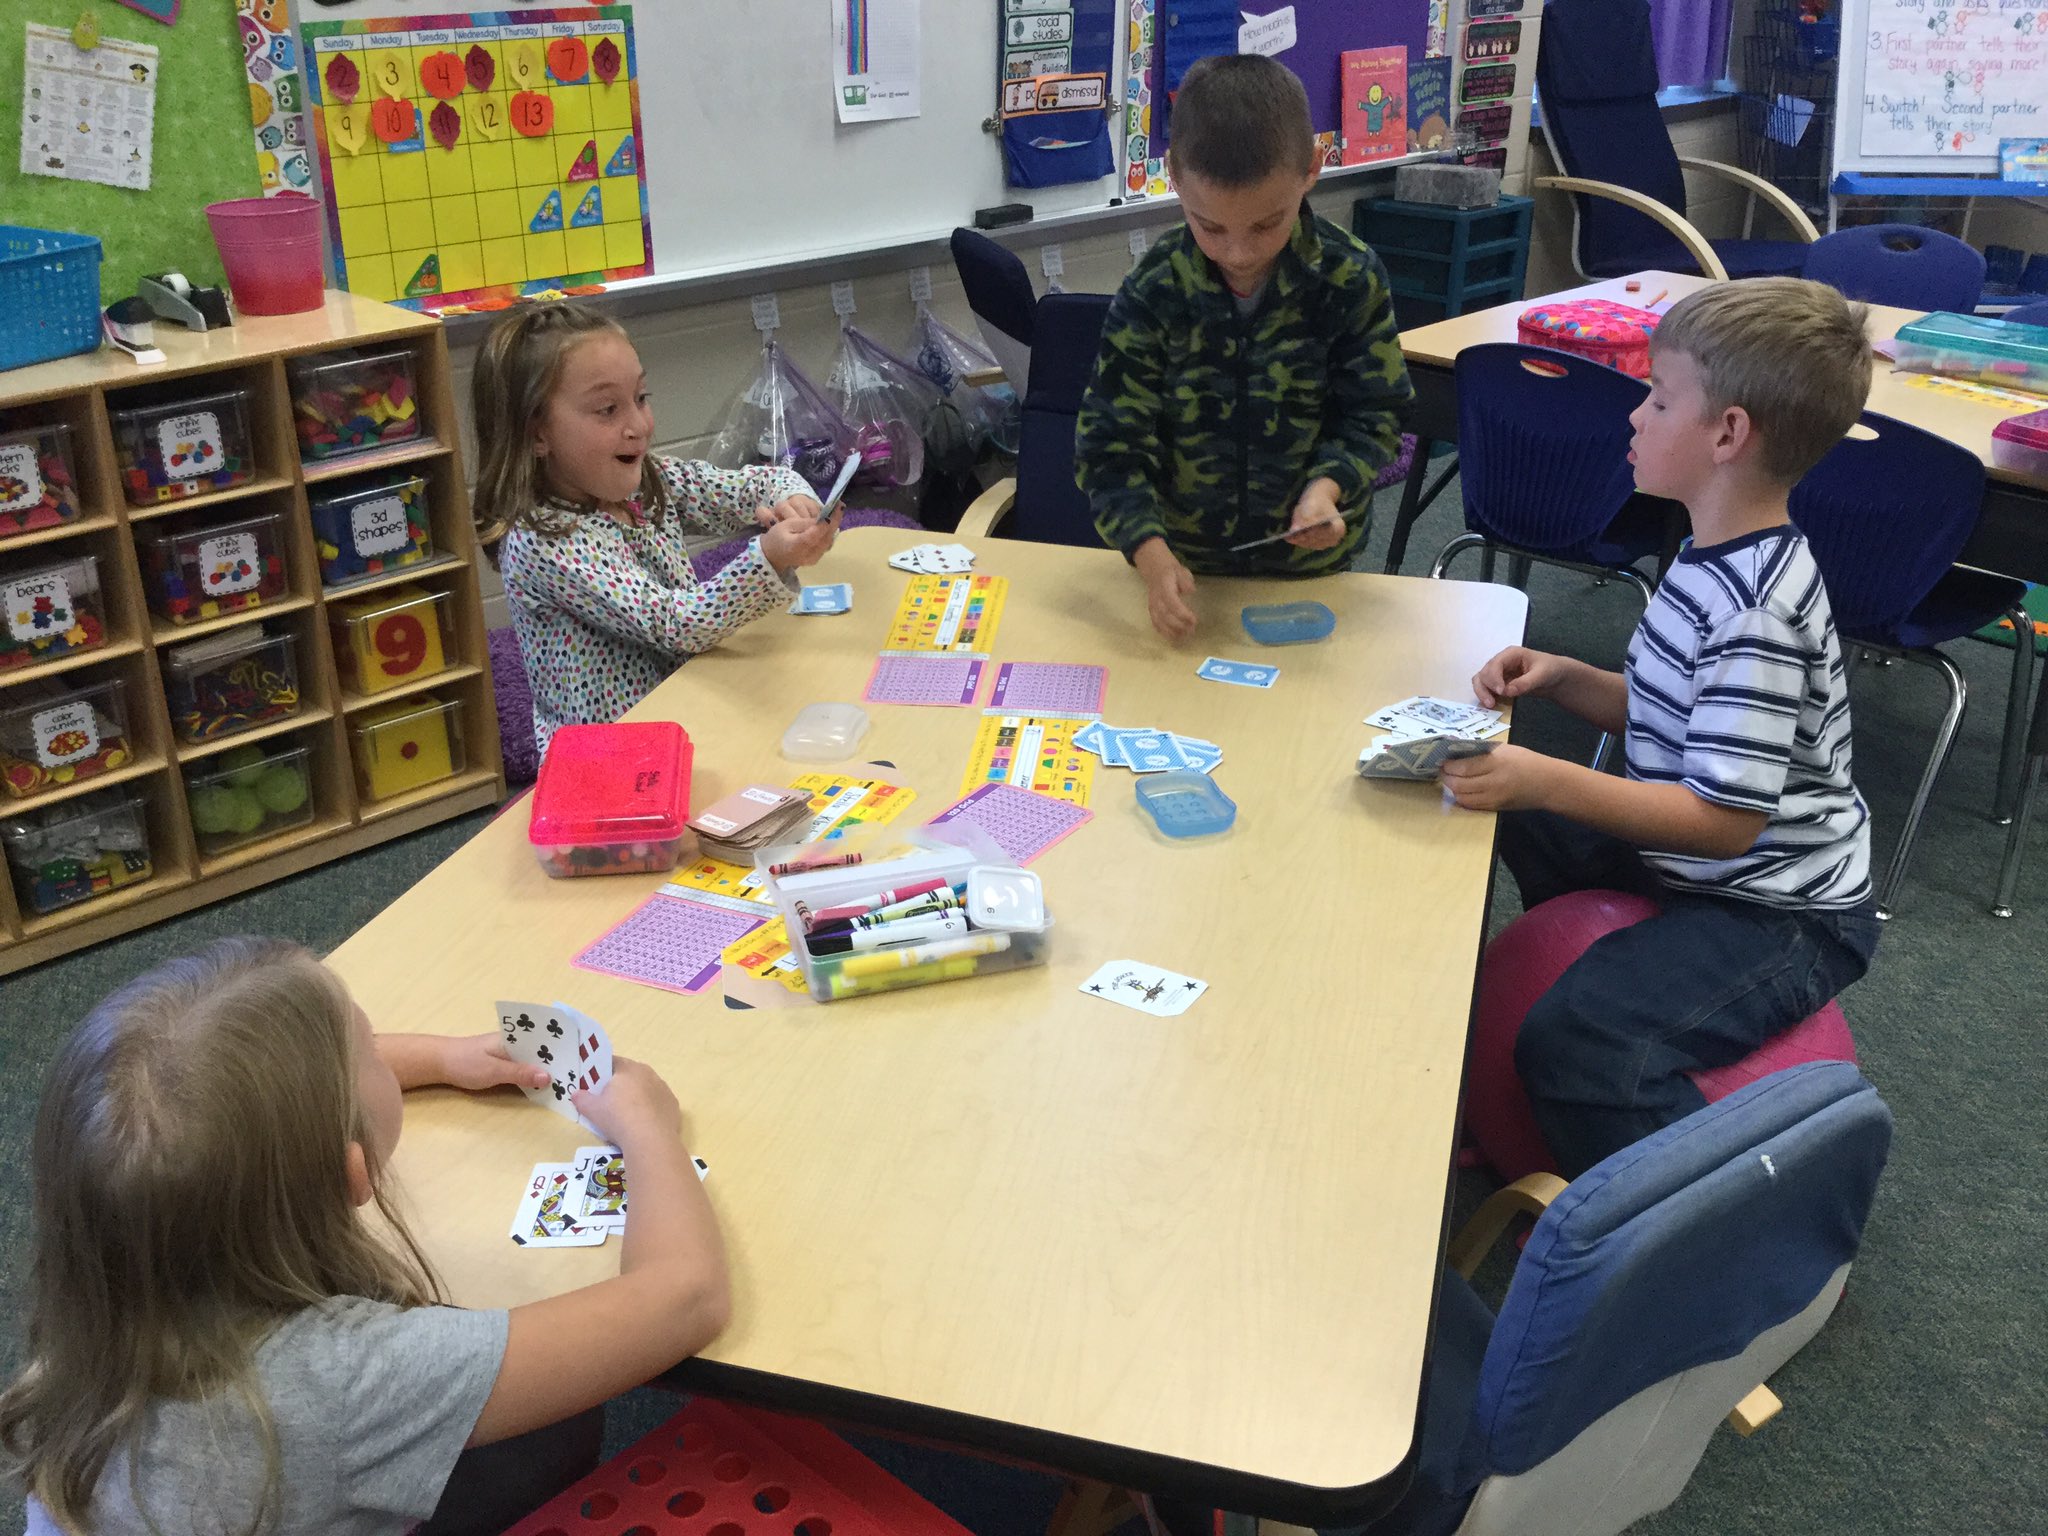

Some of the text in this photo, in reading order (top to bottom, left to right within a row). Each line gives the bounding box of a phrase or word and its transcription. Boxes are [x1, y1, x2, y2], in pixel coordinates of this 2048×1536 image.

[1037, 15, 1059, 27] social
[323, 20, 621, 49] Sunday Monday Tuesday Wednesday Thursday Friday Saturday
[1032, 29, 1063, 40] studies
[335, 48, 614, 89] 2 3 4 5 6 7 8
[1061, 85, 1099, 99] dismissal
[1992, 98, 2041, 120] partner
[341, 102, 543, 141] 9 10 11 12 13
[176, 427, 201, 438] cubes
[371, 509, 388, 524] 3d
[358, 521, 403, 540] shapes
[216, 546, 241, 558] cubes
[16, 581, 55, 598] bears
[375, 613, 427, 677] 9
[52, 712, 74, 723] color
[44, 717, 85, 735] counters
[503, 1016, 516, 1033] 5
[575, 1158, 592, 1172] J
[533, 1175, 546, 1190] Q
